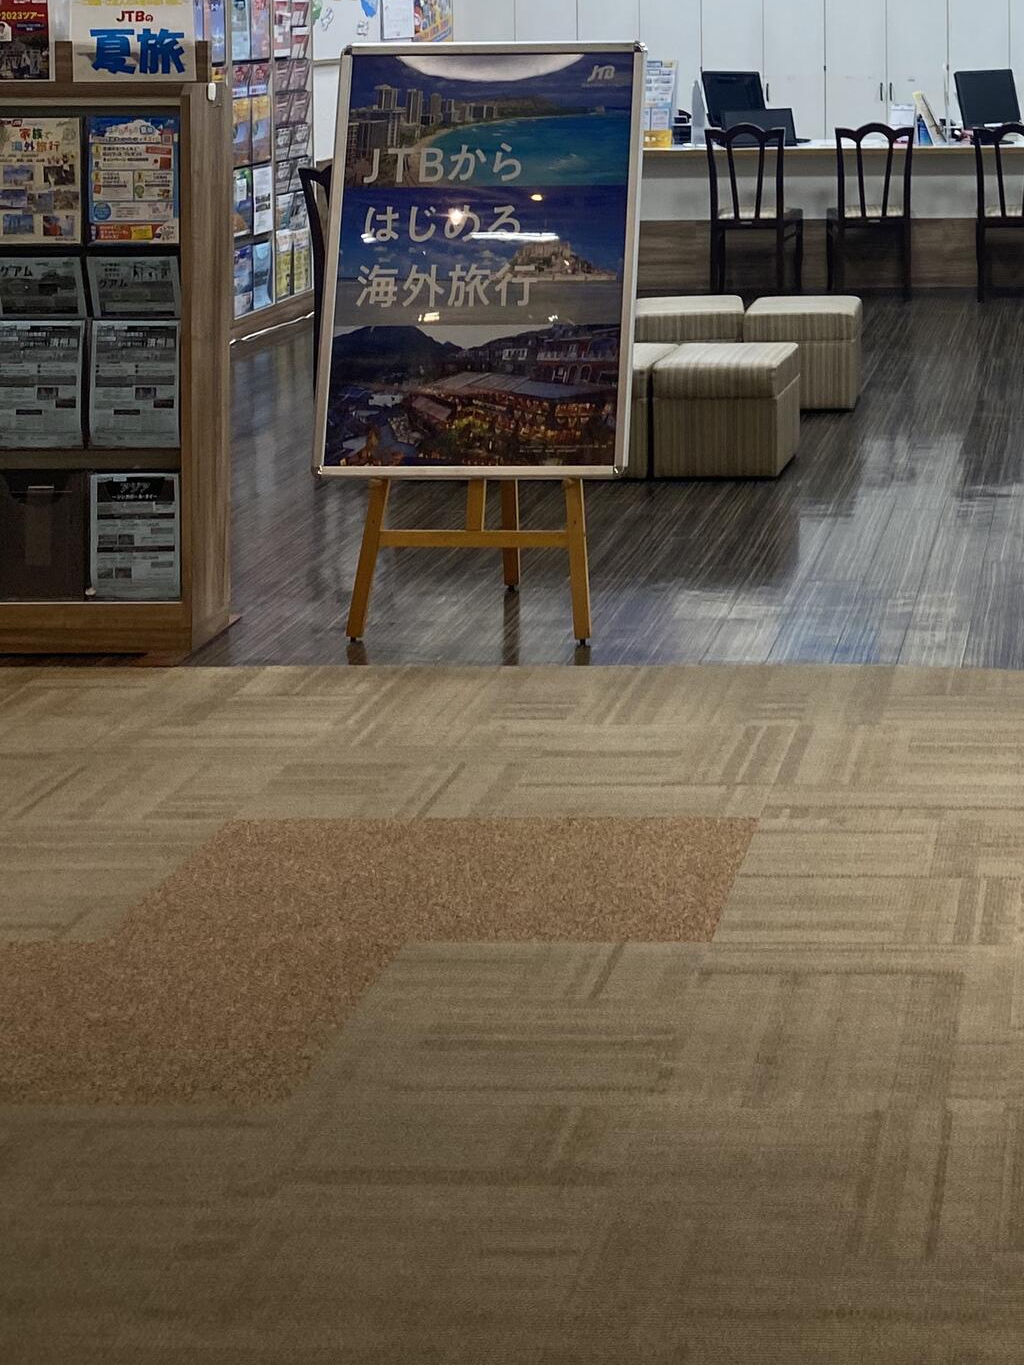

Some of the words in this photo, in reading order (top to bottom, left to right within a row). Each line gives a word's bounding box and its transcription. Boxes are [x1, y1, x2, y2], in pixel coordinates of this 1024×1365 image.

[116, 10, 153, 23] JTBの
[90, 28, 186, 75] 夏旅
[587, 65, 615, 83] JTB
[11, 141, 60, 153] 海外旅行
[363, 144, 522, 184] JTBから
[363, 204, 522, 242] はじめる
[356, 264, 538, 308] 海外旅行
